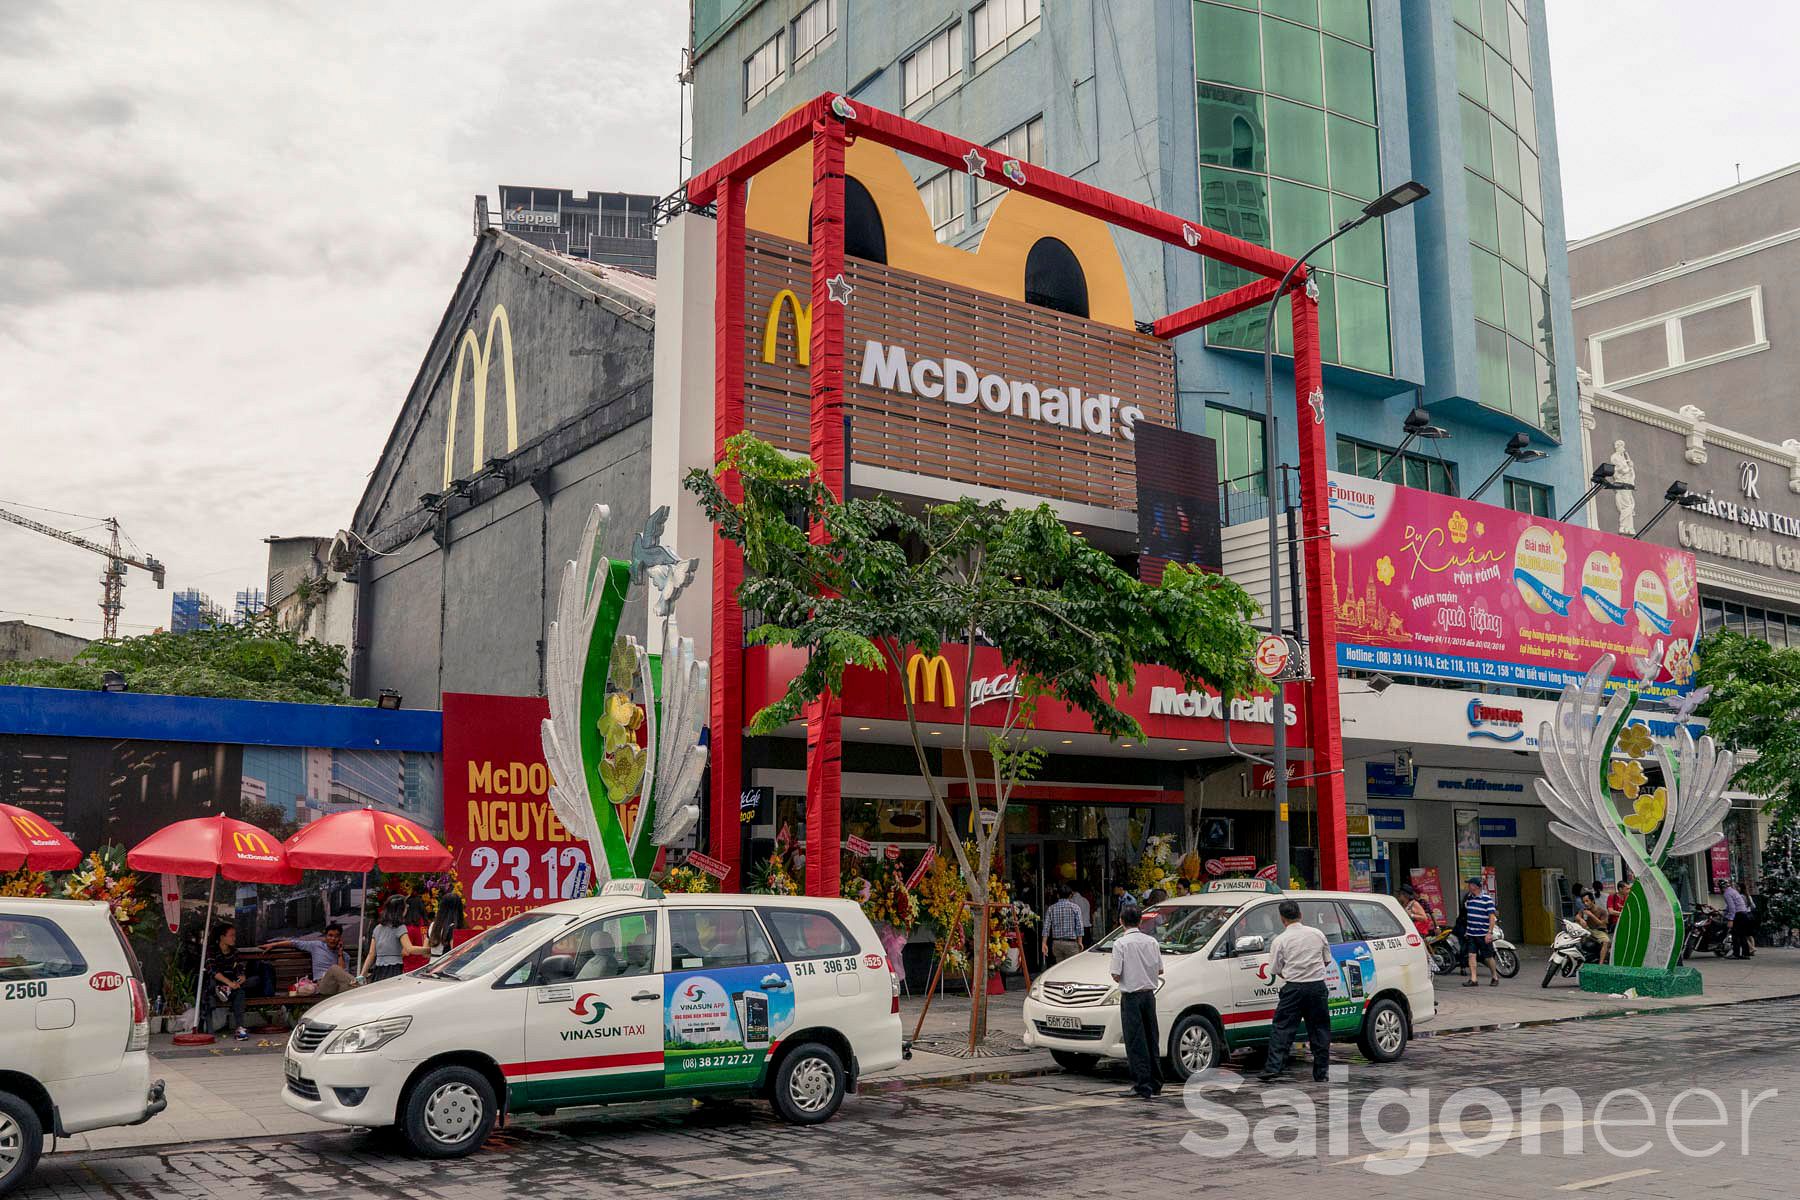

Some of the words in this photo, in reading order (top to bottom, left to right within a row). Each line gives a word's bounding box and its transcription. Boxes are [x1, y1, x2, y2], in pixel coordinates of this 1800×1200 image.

[506, 208, 558, 225] Keppel
[859, 339, 1144, 441] McDonald's
[1328, 486, 1375, 506] FIDITOUR
[1741, 506, 1769, 531] SẠN
[1772, 512, 1800, 538] KIM
[1405, 525, 1422, 541] Du
[1400, 527, 1506, 580] Xuân
[1346, 647, 1374, 663] Hotline:
[1376, 651, 1391, 665] (08)
[1392, 653, 1402, 665] 39
[1403, 654, 1412, 666] 14
[1414, 655, 1423, 668] 14
[1424, 656, 1435, 669] 14.
[1436, 658, 1449, 670] Ext:
[1450, 659, 1465, 673] 118,
[1466, 661, 1481, 674] 119,
[1482, 663, 1496, 676] 122,
[1497, 664, 1509, 677] 158
[1605, 680, 1678, 697] www.fidour.com
[1149, 686, 1297, 726] McDonalds
[1437, 778, 1524, 793] www.fiditour.com
[237, 852, 280, 862] McDonald's
[470, 846, 587, 900] 23.12
[1223, 881, 1252, 890] VINASUN
[1252, 881, 1265, 889] TAXI
[794, 962, 816, 977] 51A
[823, 959, 842, 974] 396
[844, 957, 857, 971] 39
[91, 974, 122, 988] 4706
[5, 981, 47, 1000] 2560
[1254, 985, 1281, 997] VINASU
[680, 1003, 712, 1011] VINASUN
[560, 1027, 622, 1041] VINASUN
[623, 1025, 645, 1036] TAXI
[682, 1058, 697, 1070] (08)
[699, 1057, 712, 1067] 38
[713, 1056, 725, 1066] 27
[727, 1055, 740, 1065] 27
[742, 1054, 754, 1064] 27
